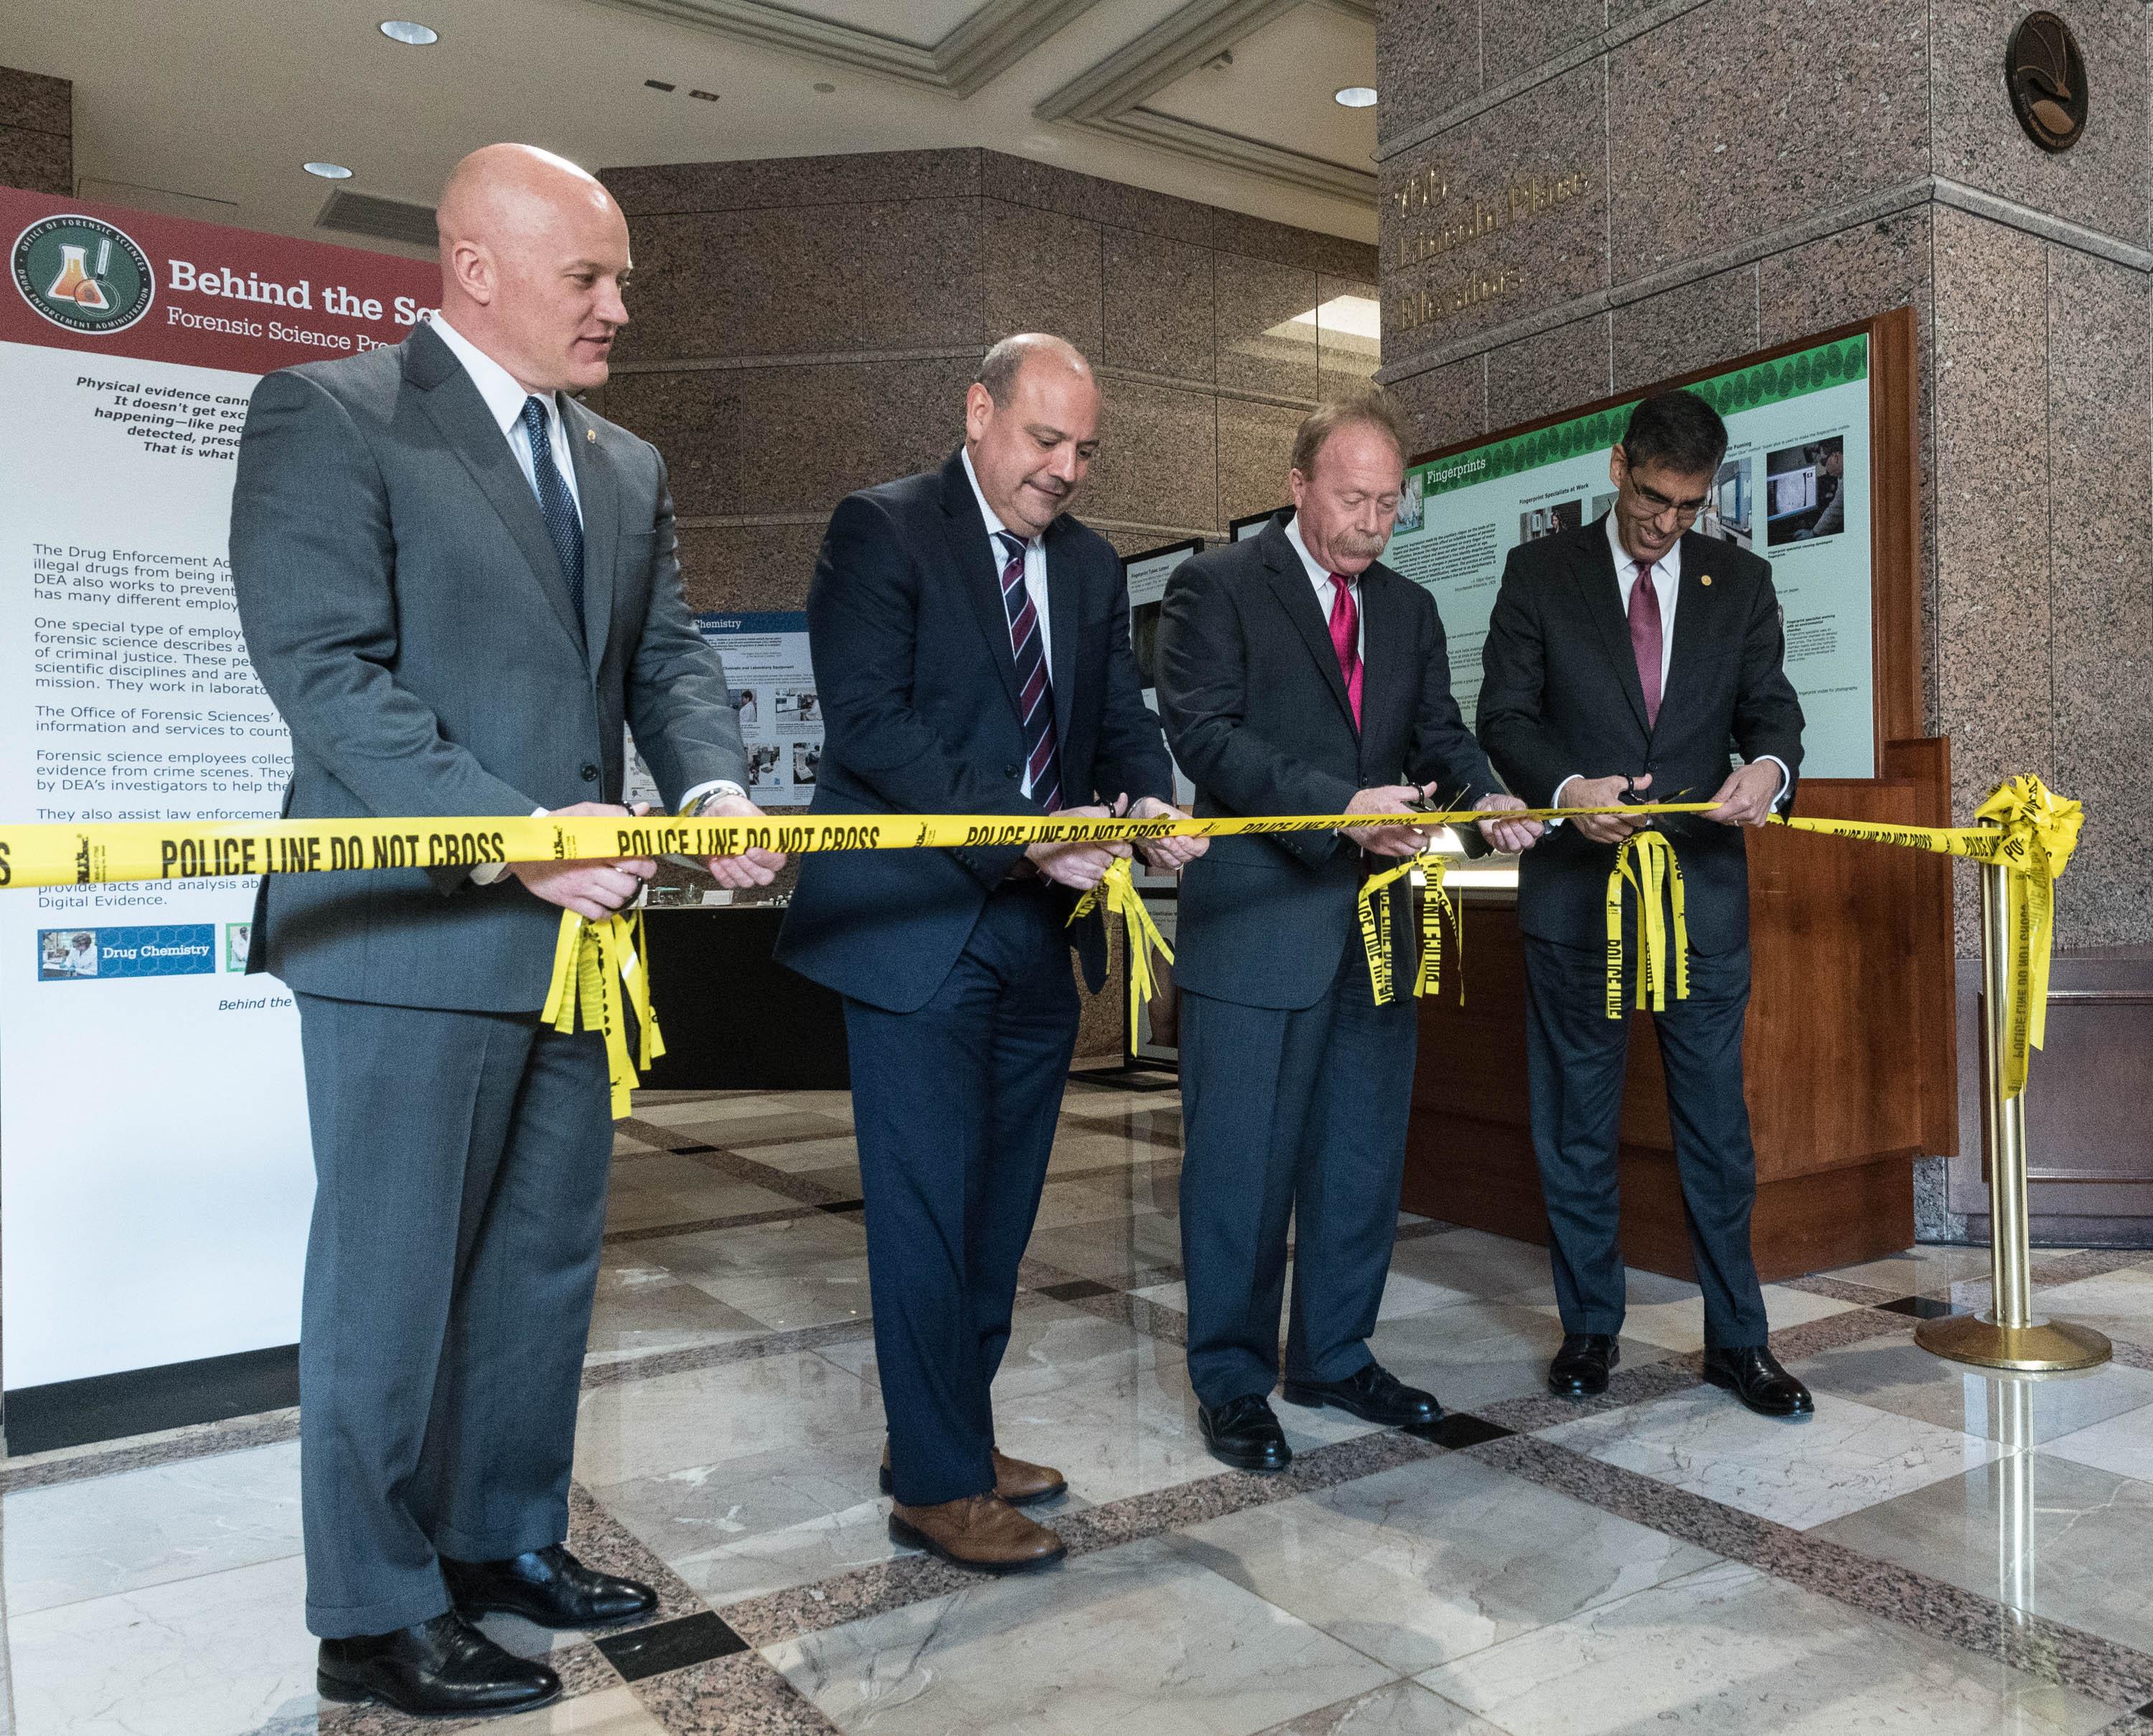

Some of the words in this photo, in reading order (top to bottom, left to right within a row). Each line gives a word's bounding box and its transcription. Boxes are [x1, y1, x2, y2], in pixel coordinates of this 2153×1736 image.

[1509, 172, 1588, 220] Place
[22, 228, 43, 251] OFFICE
[63, 220, 111, 235] FORENSIC
[115, 235, 146, 271] SCIENCES
[18, 269, 30, 291] DRUG
[30, 294, 90, 328] ENFORCEMENT
[96, 288, 149, 329] ADMINISTRATION
[167, 259, 312, 311] Behind
[322, 286, 383, 320] the
[167, 306, 262, 337] Forensic
[269, 322, 350, 349] Science
[77, 377, 140, 393] Physical
[144, 388, 210, 405] evidence
[215, 396, 250, 408] cann
[114, 396, 128, 405] It
[133, 398, 188, 413] doesn't
[192, 408, 216, 416] get
[221, 410, 245, 419] exc
[128, 426, 195, 446] detected,
[202, 431, 242, 450] prese
[1734, 441, 1752, 451] Fuming
[144, 442, 177, 454] That
[182, 446, 193, 455] is
[199, 449, 234, 459] what
[1426, 457, 1486, 484] Fingerprints
[1519, 494, 1544, 505] Fingerprint
[1545, 489, 1570, 499] Specialists
[33, 544, 62, 555] The
[70, 547, 105, 561] Drug
[113, 550, 207, 568] Enforcement
[34, 559, 78, 573] illegal
[85, 563, 128, 577] drugs
[135, 566, 169, 578] from
[176, 568, 214, 583] being
[222, 570, 235, 583] in
[34, 573, 66, 585] DEA
[73, 576, 103, 588] also
[110, 580, 154, 591] works
[161, 583, 174, 592] to
[181, 583, 238, 601] prevent
[34, 588, 61, 599] has
[69, 593, 111, 605] many
[117, 593, 180, 606] different
[187, 596, 239, 614] employ
[35, 617, 66, 629] One
[72, 621, 123, 632] special
[131, 624, 163, 636] type
[169, 625, 184, 635] of
[189, 627, 240, 640] employ
[34, 632, 96, 645] forensic
[103, 638, 157, 648] science
[164, 639, 232, 652] describes
[35, 647, 50, 657] of
[57, 650, 116, 660] criminal
[123, 652, 177, 663] justice.
[184, 654, 226, 665] These
[35, 663, 103, 674] scientific
[110, 665, 186, 678] disciplines
[192, 669, 217, 679] and
[36, 679, 99, 688] mission.
[106, 679, 143, 693] They
[150, 682, 185, 691] work
[210, 681, 268, 695] laborato
[35, 706, 64, 716] The
[71, 707, 115, 718] Office
[121, 708, 136, 718] of
[142, 709, 202, 721] Forensic
[37, 721, 126, 732] information
[133, 723, 159, 733] and
[166, 726, 224, 735] services
[230, 726, 243, 736] to
[37, 750, 101, 761] Forensic
[108, 751, 162, 762] science
[169, 753, 246, 765] employees
[37, 765, 105, 775] evidence
[113, 766, 147, 776] from
[154, 766, 194, 776] crime
[260, 765, 294, 781] They
[37, 779, 55, 792] by
[112, 782, 207, 793] investigators
[213, 782, 226, 791] to
[233, 782, 262, 793] help
[268, 782, 289, 793] the
[37, 809, 75, 821] They
[82, 809, 112, 819] also
[118, 810, 161, 819] assist
[167, 810, 190, 819] law
[197, 807, 283, 820] enforcemen
[617, 828, 688, 856] POLICE
[696, 827, 738, 855] LINE
[744, 827, 771, 853] DO
[779, 827, 814, 853] NOT
[818, 825, 881, 851] CROSS
[963, 826, 1025, 846] POLICE
[1963, 835, 1990, 857] POLICE
[161, 838, 255, 878] POLICE
[266, 837, 321, 873] LINE
[332, 835, 362, 871] DO
[372, 835, 420, 869] NOT
[429, 832, 505, 865] CROSS
[101, 881, 139, 891] facts
[145, 880, 172, 891] and
[179, 879, 236, 891] analysis
[242, 878, 260, 891] ab
[39, 896, 88, 910] Digital
[95, 896, 166, 906] Evidence.
[103, 947, 137, 959] Drug
[141, 945, 210, 957] Chemistry
[219, 998, 266, 1010] Behind
[271, 998, 291, 1007] the
